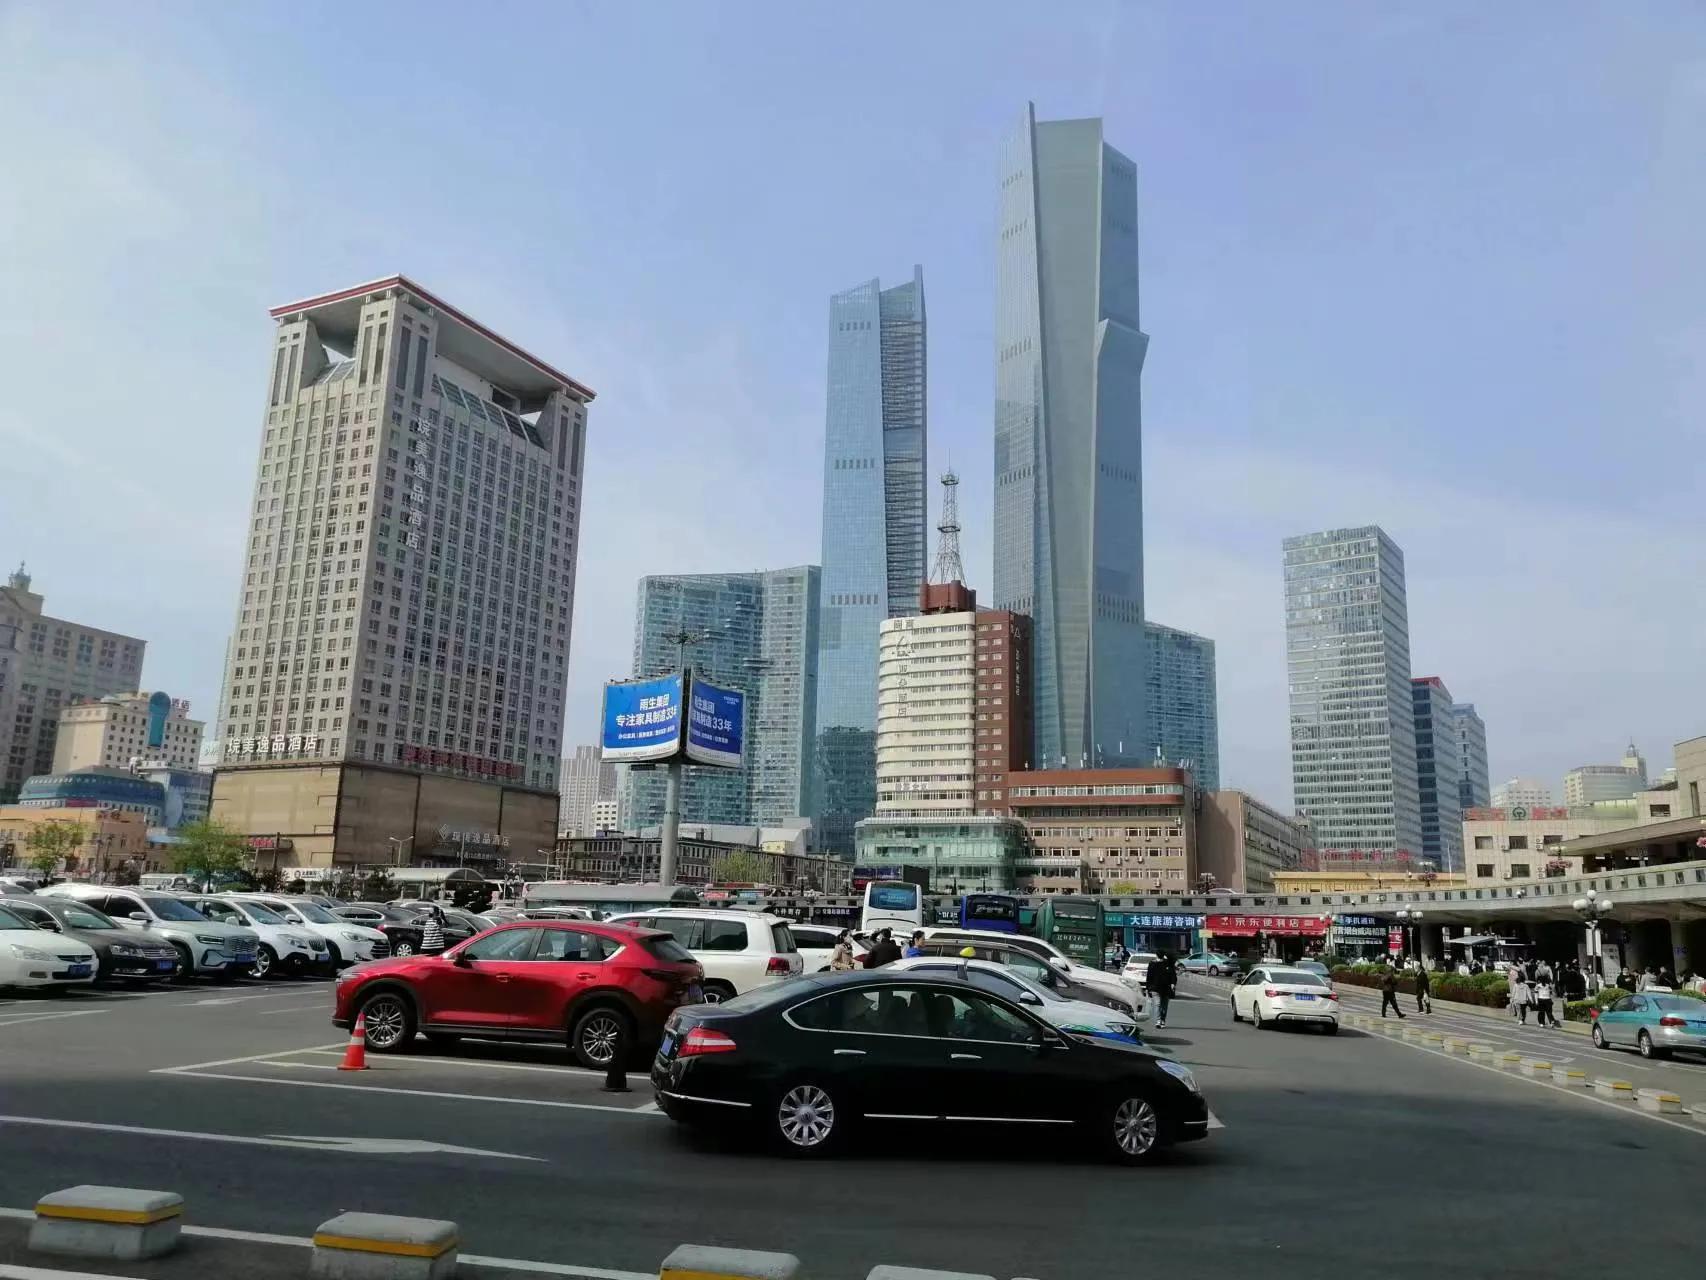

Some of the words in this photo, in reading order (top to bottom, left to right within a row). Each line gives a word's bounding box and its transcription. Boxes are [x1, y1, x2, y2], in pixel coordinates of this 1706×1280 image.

[639, 693, 670, 711] 雨生集团
[1130, 915, 1195, 927] 大连旅游咨询
[1235, 917, 1300, 928] 京东便利店
